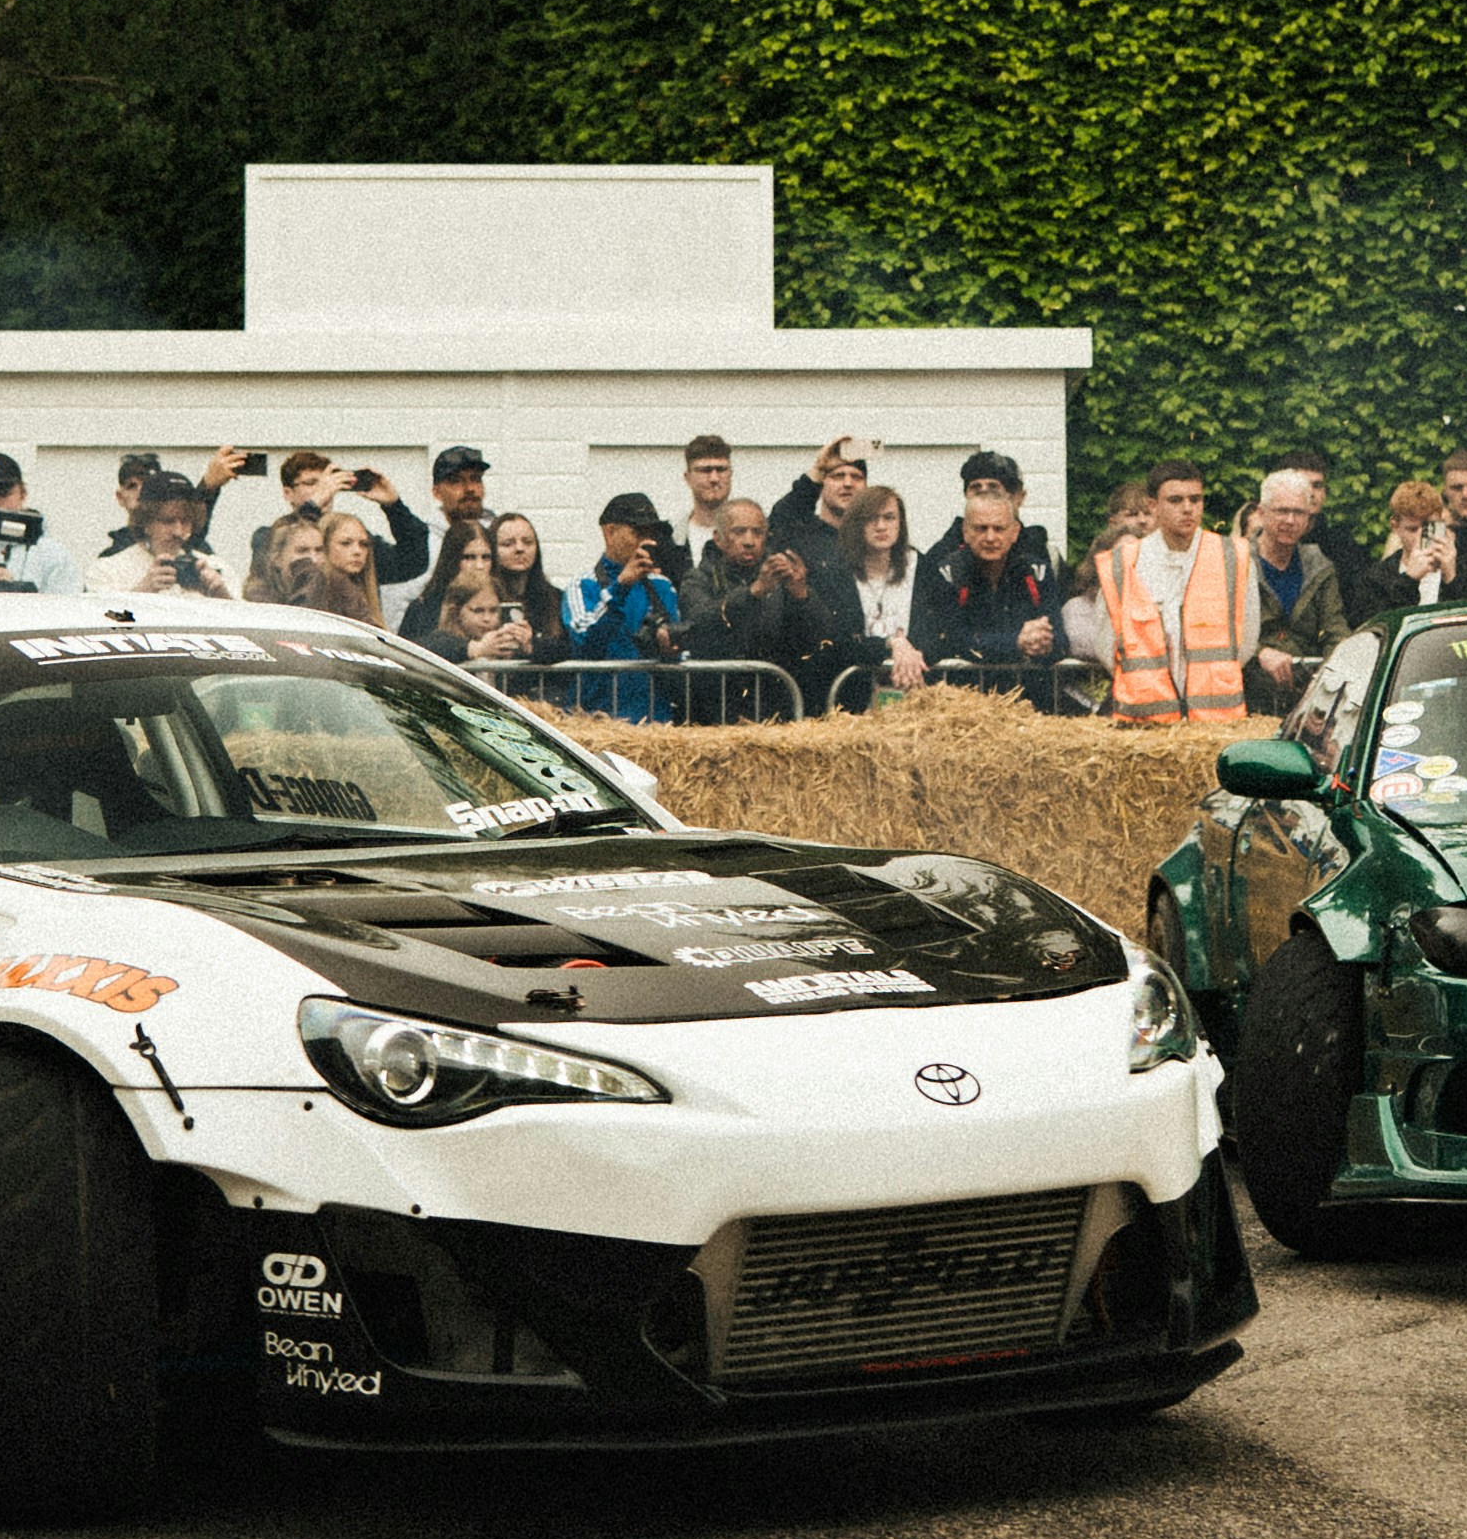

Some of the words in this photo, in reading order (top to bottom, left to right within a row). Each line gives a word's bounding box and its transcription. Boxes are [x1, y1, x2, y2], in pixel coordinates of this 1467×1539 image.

[9, 633, 267, 660] INITIATE
[444, 793, 604, 839] Snap-on
[257, 1286, 343, 1314] OWEN
[264, 1331, 333, 1363] Bean
